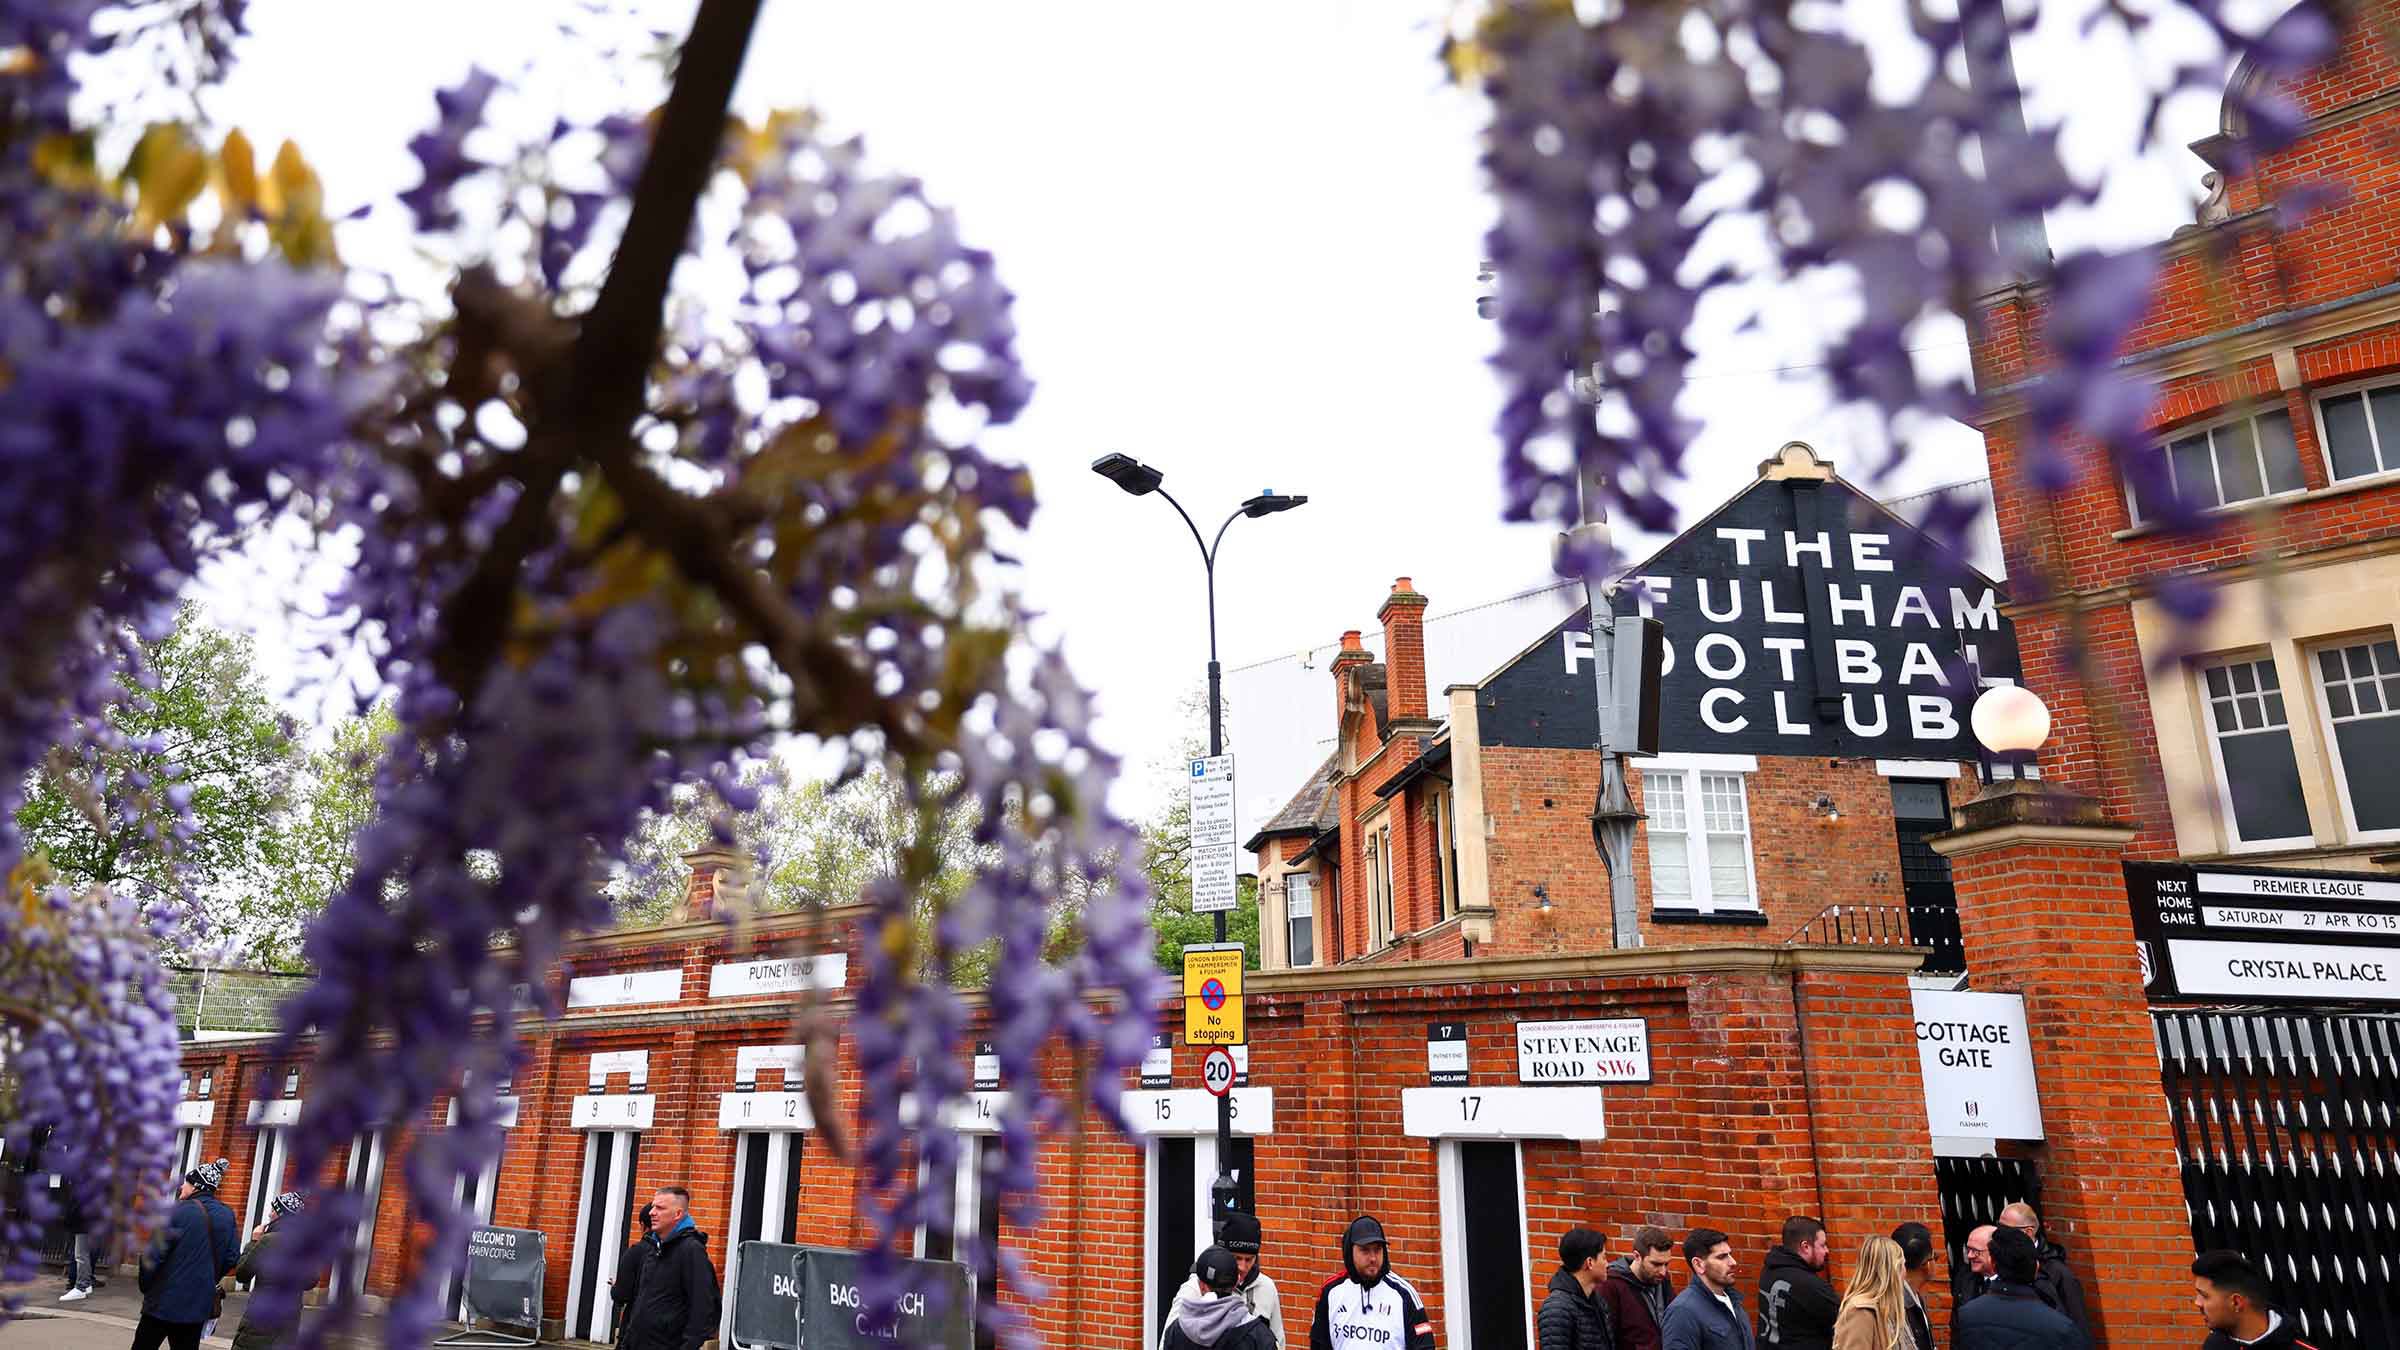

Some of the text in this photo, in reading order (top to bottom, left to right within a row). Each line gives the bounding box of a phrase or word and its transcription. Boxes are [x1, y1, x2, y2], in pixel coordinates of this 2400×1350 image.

[1716, 528, 1893, 571] THE
[1635, 576, 1999, 630] FULHAM
[1700, 687, 1959, 740] CLUB
[2156, 880, 2188, 893] NEXT
[2253, 879, 2365, 896] PREMIER LEAGUE
[2157, 896, 2193, 909] HOME
[2160, 912, 2196, 925] GAME
[2218, 910, 2284, 925] SATURDAY
[2303, 913, 2316, 926] 27
[2325, 914, 2351, 927] APR
[2357, 915, 2377, 928] KO
[749, 961, 814, 980] PUTNEY END
[2228, 960, 2387, 982] CRYSTAL PALACE
[1207, 1015, 1221, 1025] No
[1152, 1035, 1161, 1046] 15
[1193, 1029, 1235, 1040] stopping
[1440, 1026, 1452, 1038] 17
[1915, 1022, 2010, 1044] COTTAGE
[984, 1043, 993, 1053] 14
[1523, 1036, 1641, 1055] STEVENAGE
[1939, 1048, 1992, 1068] GATE
[1206, 1061, 1229, 1081] 20
[1533, 1060, 1636, 1078] ROAD SW6
[592, 1101, 637, 1117] 9 10
[743, 1099, 797, 1117] 11 12
[977, 1099, 990, 1119] 14
[1155, 1098, 1171, 1120] 15
[1461, 1096, 1481, 1121] 17
[505, 1233, 516, 1247] TO
[490, 1247, 516, 1260] COTTAGE
[829, 1283, 860, 1308] BAG
